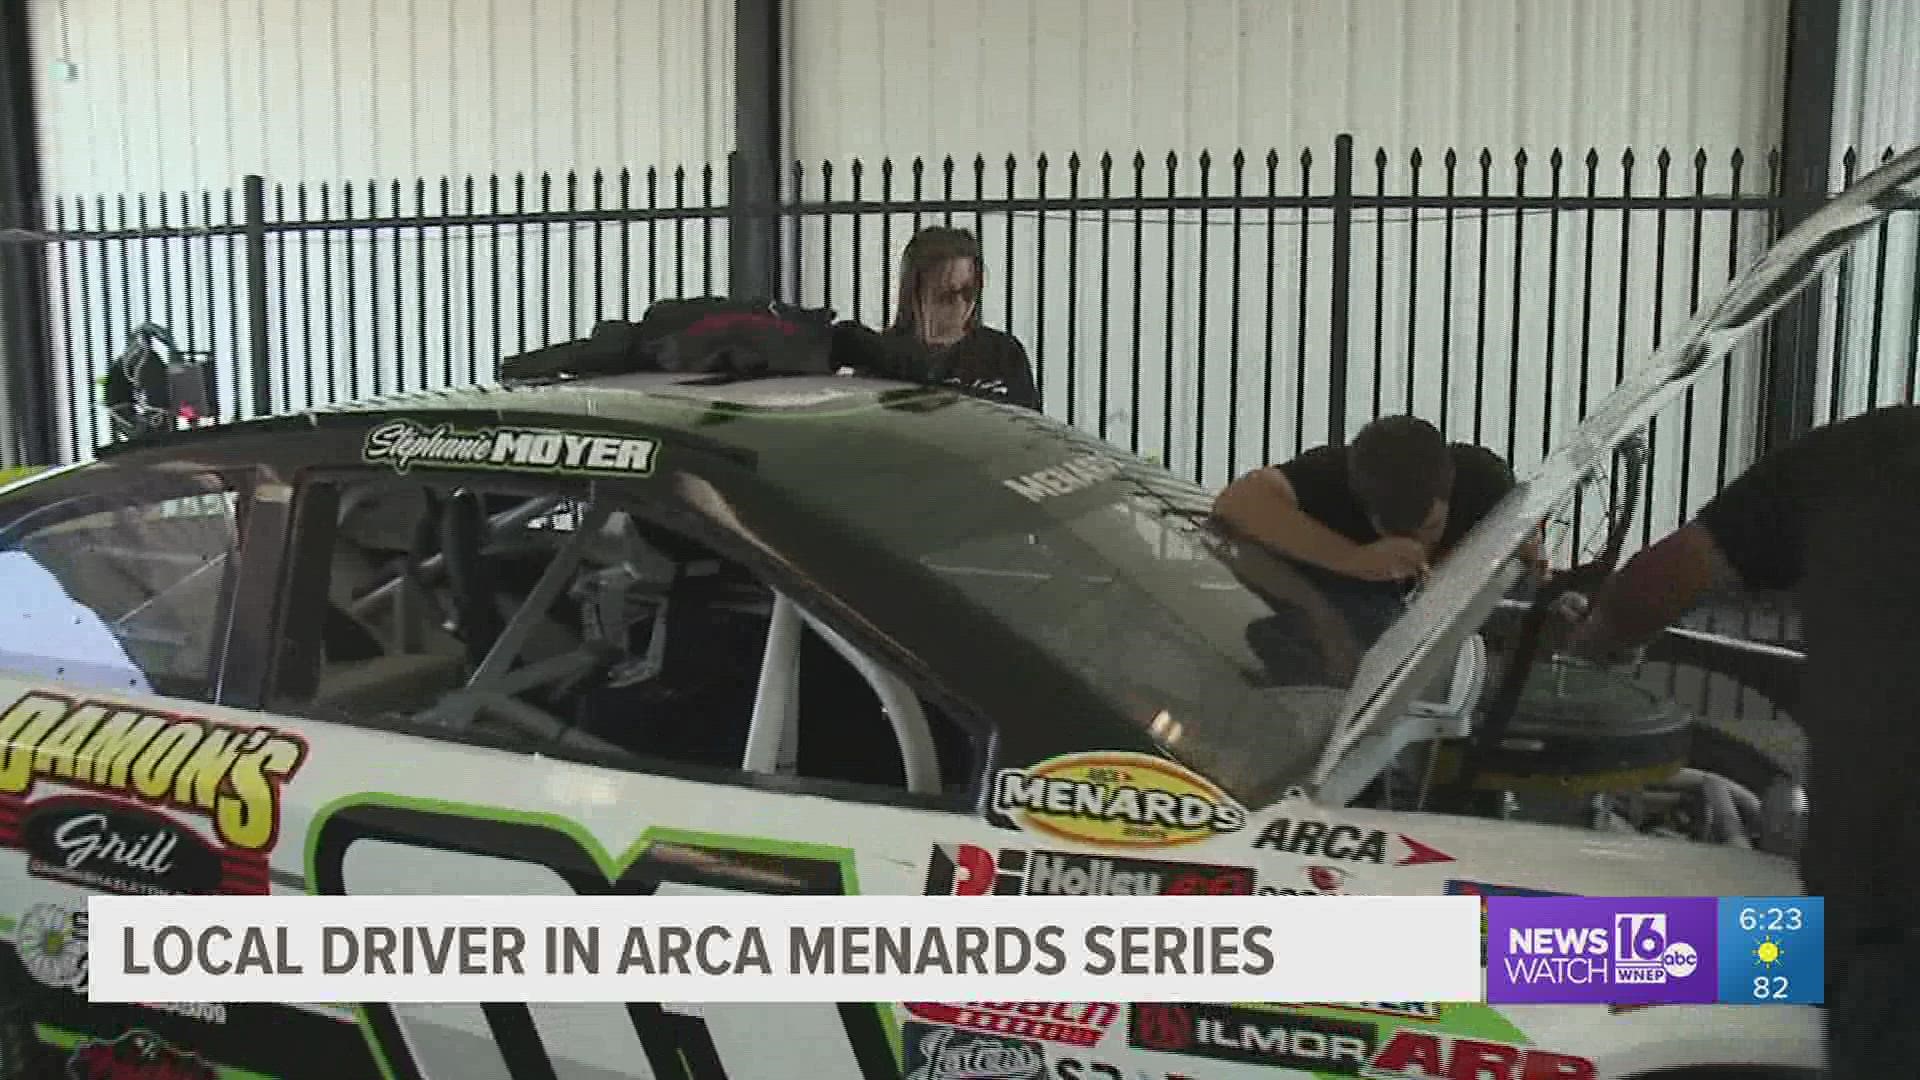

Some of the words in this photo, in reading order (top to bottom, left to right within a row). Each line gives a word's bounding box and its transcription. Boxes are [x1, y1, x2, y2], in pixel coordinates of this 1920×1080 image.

[364, 422, 492, 466] Stephanie
[490, 431, 655, 472] MOYER
[0, 692, 302, 849] DAMON'S
[1002, 774, 1246, 831] MENARDS
[55, 813, 177, 874] Grill
[1250, 818, 1388, 865] ARCA
[1028, 854, 1163, 896] Holley
[1196, 1019, 1366, 1062] ILMOR
